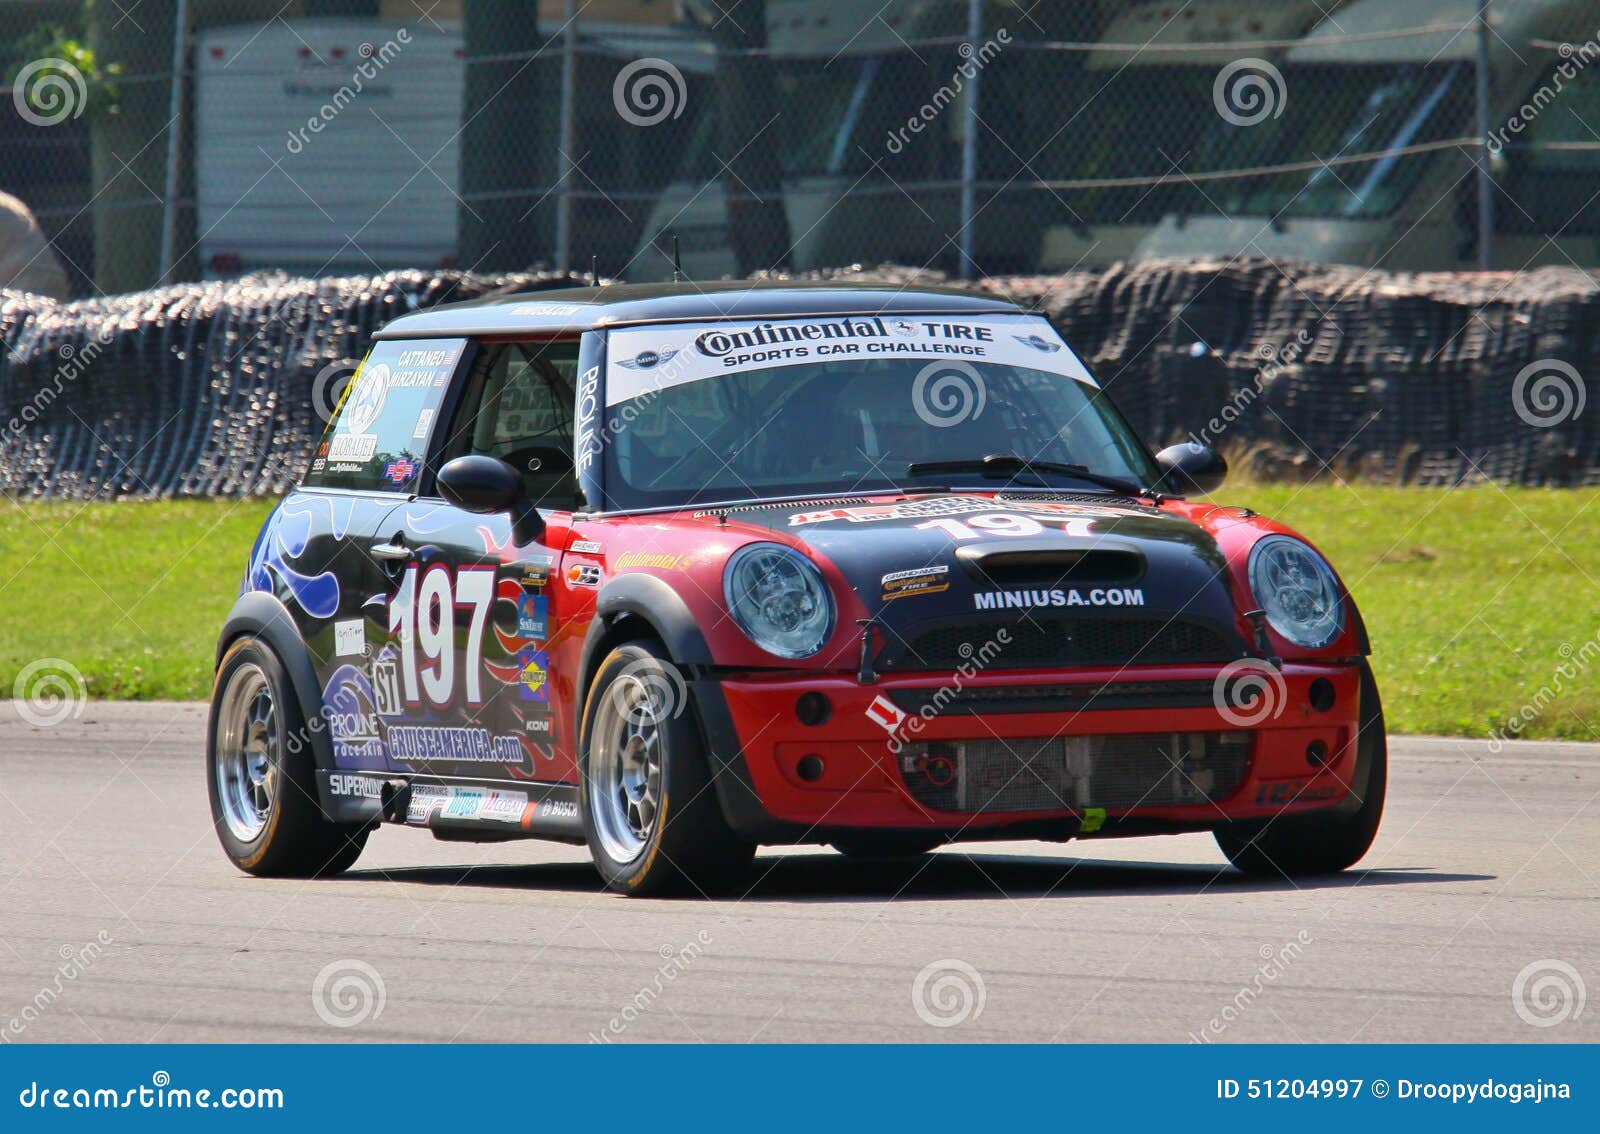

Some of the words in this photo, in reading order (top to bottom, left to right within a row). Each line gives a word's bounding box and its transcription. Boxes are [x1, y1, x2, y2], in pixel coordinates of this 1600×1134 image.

[695, 316, 889, 358] Continental
[921, 322, 995, 342] TIRE
[723, 347, 810, 367] SPORTS
[816, 343, 860, 355] CAR
[867, 342, 986, 357] CHALLENGE
[914, 513, 1098, 540] 197
[973, 588, 1145, 610] MINIUSA.COM
[387, 562, 497, 708] 197
[331, 713, 379, 738] PROLINE
[525, 720, 549, 732] KONI
[387, 725, 524, 763] CRUISEAMERICA.com
[551, 801, 578, 817] BOSCH
